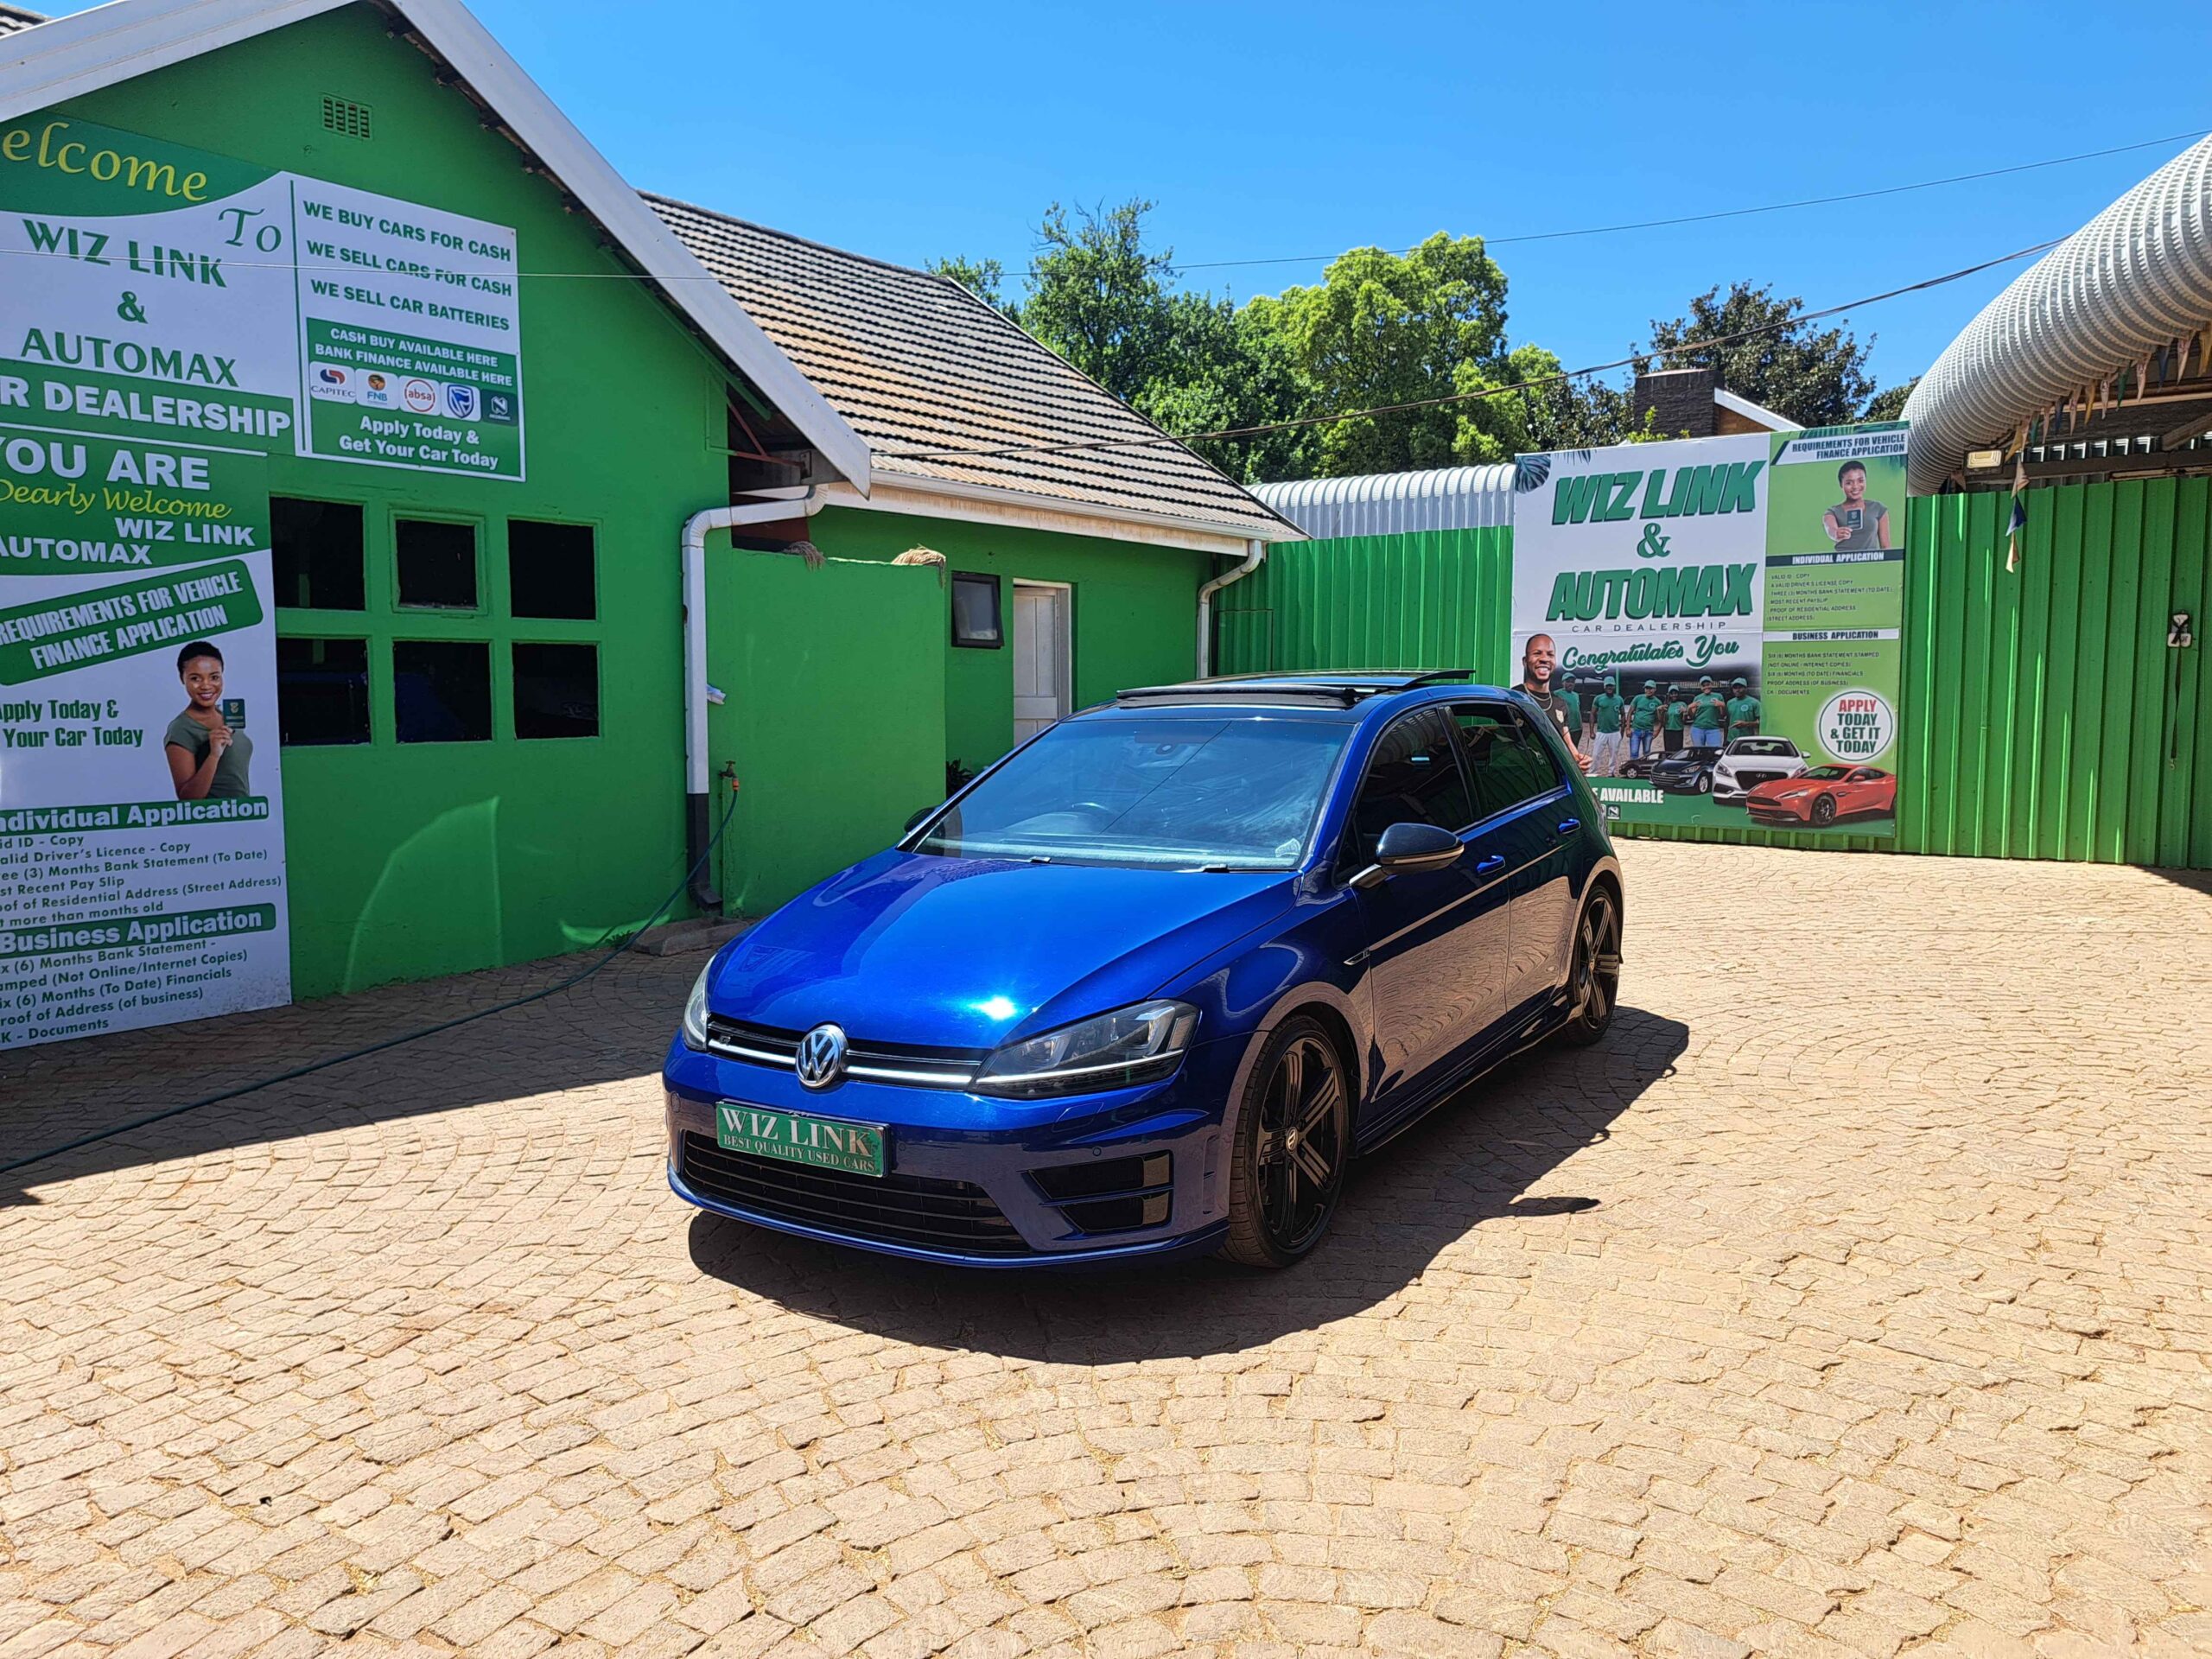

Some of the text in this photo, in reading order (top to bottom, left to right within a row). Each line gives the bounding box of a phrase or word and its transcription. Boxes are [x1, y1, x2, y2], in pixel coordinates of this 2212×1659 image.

[218, 207, 282, 253] To
[303, 200, 512, 262] WE BUY CARS FOR CASH
[22, 219, 227, 288] WIZ LINK
[306, 239, 512, 297] WE SELL CARS FOR CASH
[117, 290, 149, 324] &
[310, 279, 510, 331] WE SELL CAR BATTERIES
[20, 327, 239, 388] AUTOMAX
[330, 327, 499, 368] CASH BUY AVAILABLE HERE
[315, 343, 513, 387] BANK FINANCE AVAILABLE HERE
[310, 385, 356, 398] CAPITEC
[367, 391, 387, 402] FNB
[408, 386, 433, 401] absa
[43, 380, 291, 438] DEALERSHIP
[359, 415, 480, 445] Apply Today &
[1792, 433, 1905, 452] REQUIREMENTS FOR VEHICLE
[0, 436, 210, 491] OU ARE
[339, 435, 499, 471] Get Your Car Today
[1816, 443, 1905, 460] FINANCE APPLICATION
[103, 486, 232, 518] Welcome
[1551, 460, 1767, 525] WIZ LINK
[114, 517, 256, 547] WIZ LINK
[1637, 522, 1671, 559] &
[1792, 551, 1885, 565] INDIVIDUAL APPLICATION
[137, 587, 174, 613] FOR
[172, 571, 243, 605] VEHICLE
[1545, 563, 1758, 622] AUTOMAX
[29, 605, 228, 670] FINANCE APPLICATION
[1571, 621, 1726, 633] CAR DEALERSHIP
[1792, 631, 1879, 640] BUSINESS APPLICATION
[1562, 634, 1740, 672] Congratulates You
[0, 699, 118, 722] pply Today &
[1837, 713, 1878, 726] TODAY
[1839, 699, 1877, 712] APPLY
[3, 727, 143, 748] Your Car Today
[1830, 727, 1881, 740] & GET IT
[1836, 740, 1877, 753] TODAY
[1599, 787, 1664, 804] AVAILABLE
[127, 799, 268, 827] Application
[19, 836, 34, 848] ID
[50, 835, 84, 847] Copy
[97, 847, 146, 858] Licence
[160, 842, 191, 854] Copy
[24, 868, 43, 881] (3)
[48, 863, 100, 877] Months
[105, 860, 139, 872] Bank
[143, 855, 209, 868] Statement
[213, 852, 231, 864] (To
[235, 849, 267, 861] Date)
[17, 881, 66, 895] Recent
[70, 880, 94, 891] Pay
[99, 876, 124, 888] Slip
[23, 898, 37, 910] of
[42, 890, 121, 908] Residential
[125, 887, 179, 899] Address
[182, 881, 225, 896] (Street
[228, 875, 282, 889] Address)
[10, 916, 47, 928] more
[52, 912, 84, 923] than
[89, 905, 138, 918] months
[143, 901, 163, 912] old
[0, 911, 262, 954] Business Application
[15, 959, 35, 975] (6)
[40, 953, 93, 969] Months
[98, 947, 134, 962] Bank
[138, 940, 207, 957] Statement
[53, 971, 84, 987] (Not
[200, 949, 248, 966] Copies)
[16, 994, 36, 1009] (6)
[41, 986, 95, 1003] Months
[99, 982, 120, 997] (To
[124, 976, 162, 992] Date)
[166, 967, 232, 986] Financials
[36, 1007, 51, 1021] of
[55, 1002, 114, 1019] Address
[118, 995, 137, 1012] (of
[141, 987, 204, 1007] business)
[29, 1019, 110, 1039] Documents
[721, 1107, 873, 1158] WIZ LINK
[724, 1134, 875, 1172] BEST QUALITY USED CARS
